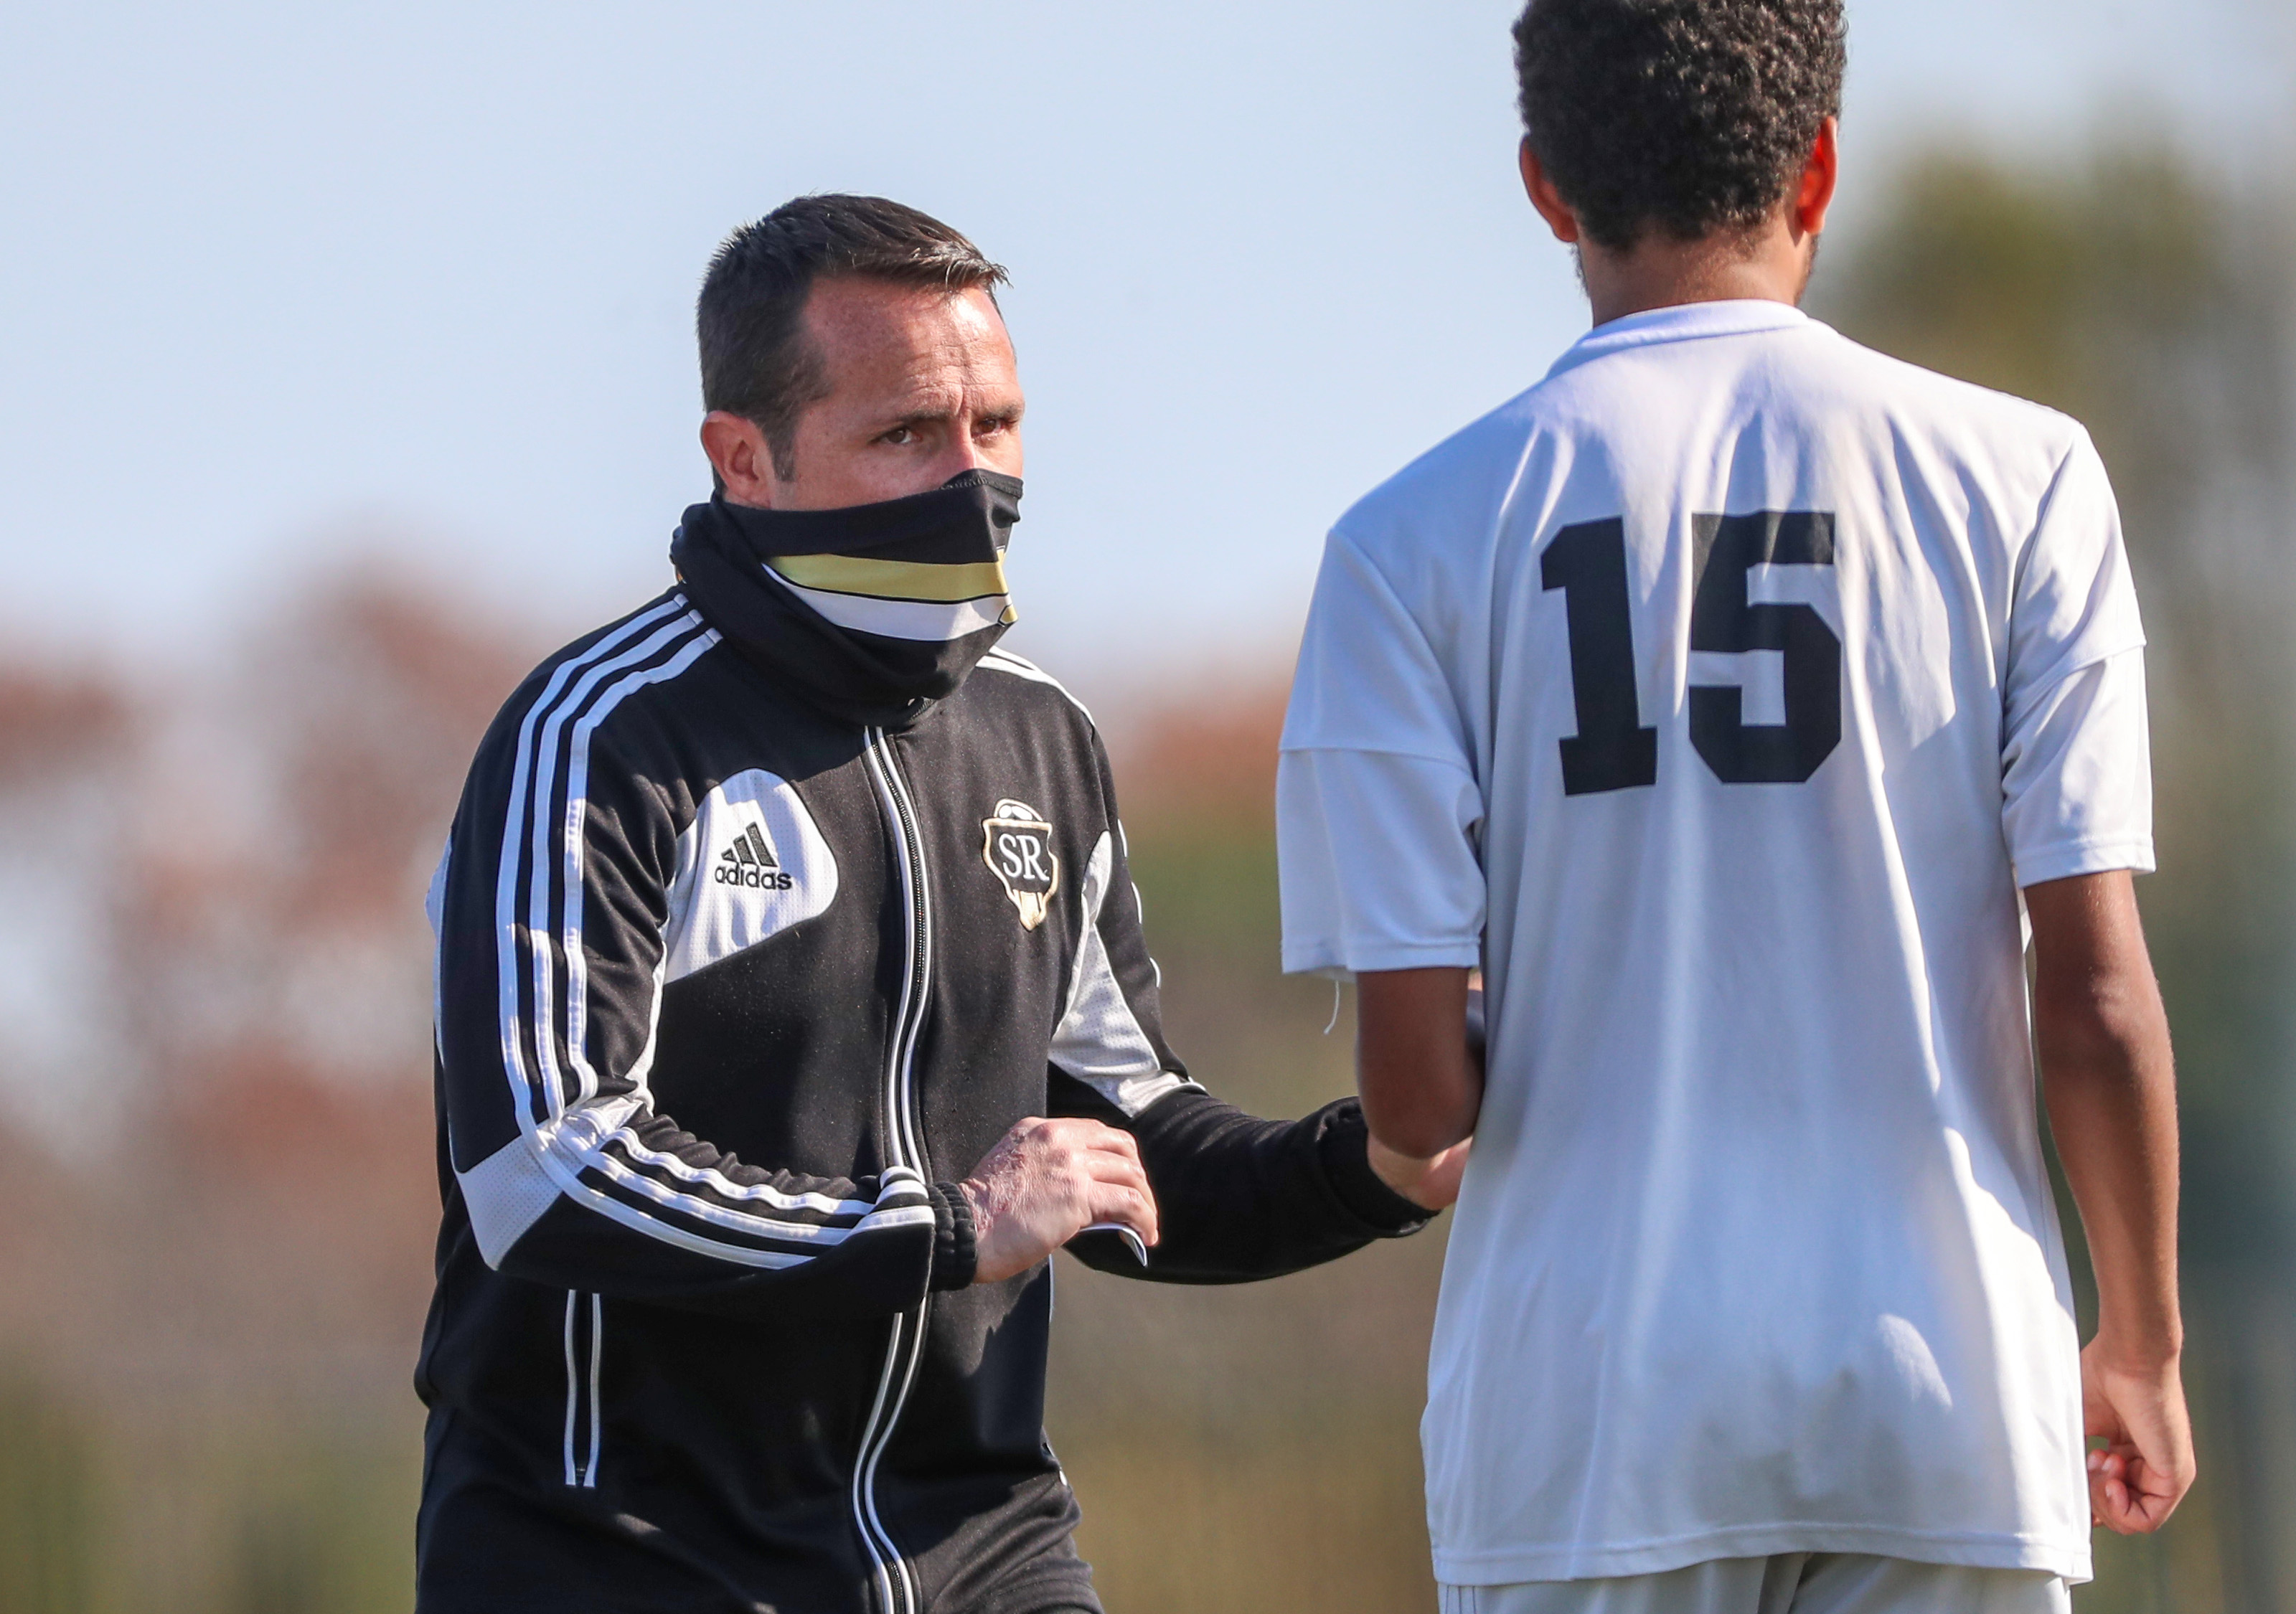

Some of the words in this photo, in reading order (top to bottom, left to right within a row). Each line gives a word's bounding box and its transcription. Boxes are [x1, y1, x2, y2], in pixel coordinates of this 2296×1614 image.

[1540, 511, 1842, 796] 15
[715, 862, 792, 890] adidas
[998, 833, 1050, 882] SR
